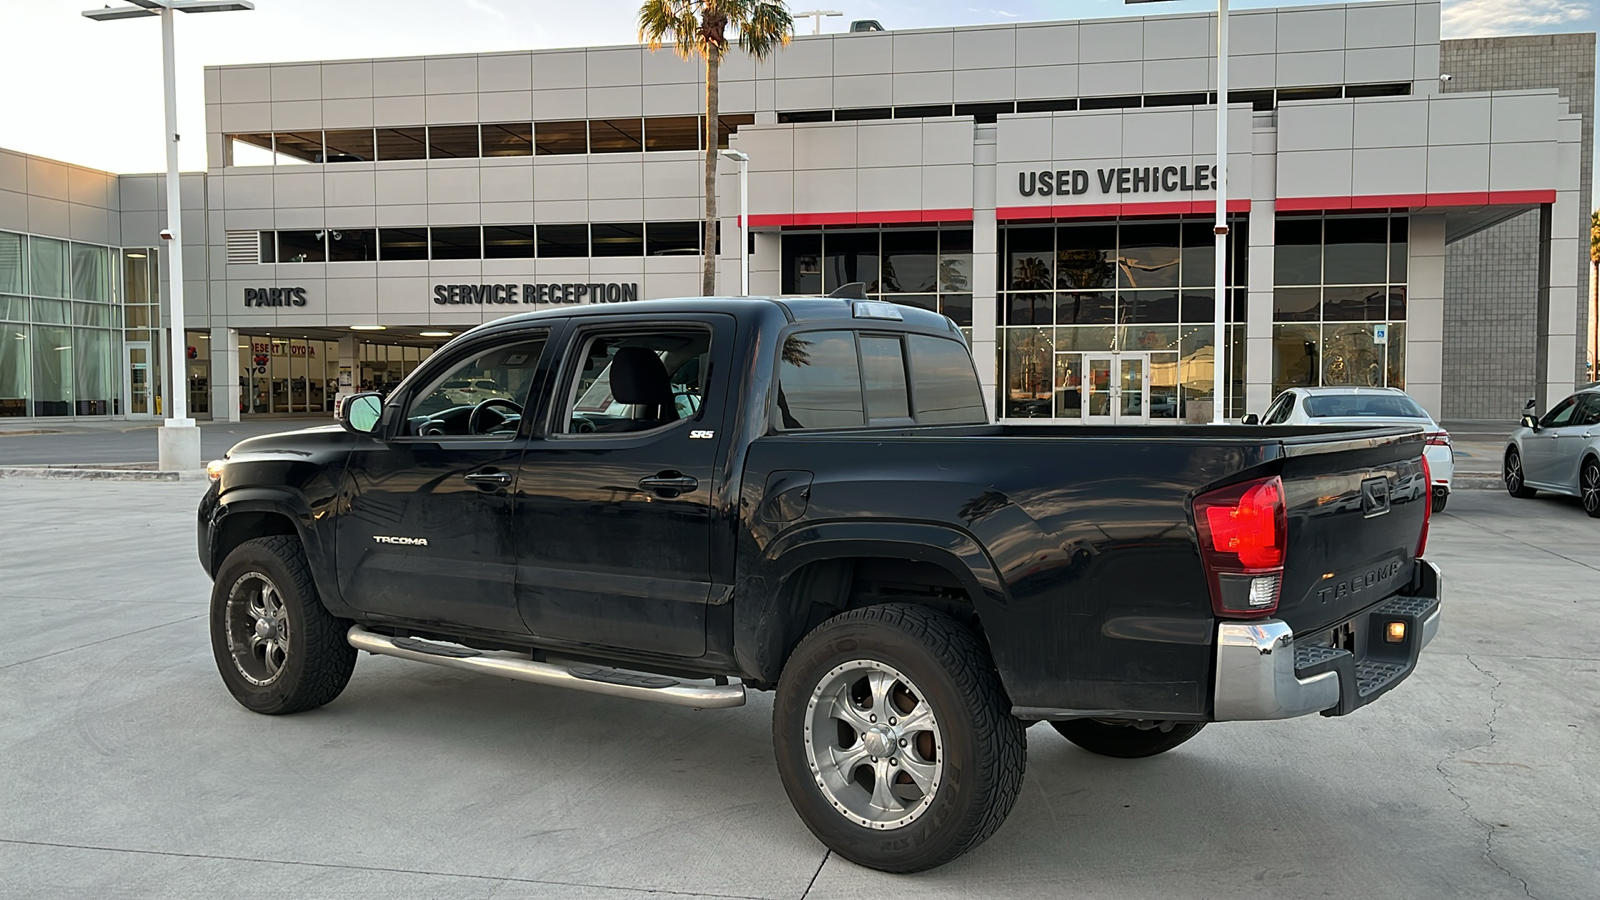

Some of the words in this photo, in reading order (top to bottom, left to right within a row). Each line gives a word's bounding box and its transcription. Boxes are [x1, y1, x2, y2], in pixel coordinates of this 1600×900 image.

[1018, 170, 1089, 196] USED
[243, 287, 306, 307] PARTS
[433, 283, 518, 305] SERVICE
[523, 282, 638, 304] RECEPTION
[290, 345, 315, 355] OYOA
[689, 430, 715, 439] SR5
[372, 535, 429, 546] TACOMA
[1317, 561, 1400, 604] TACOMA
